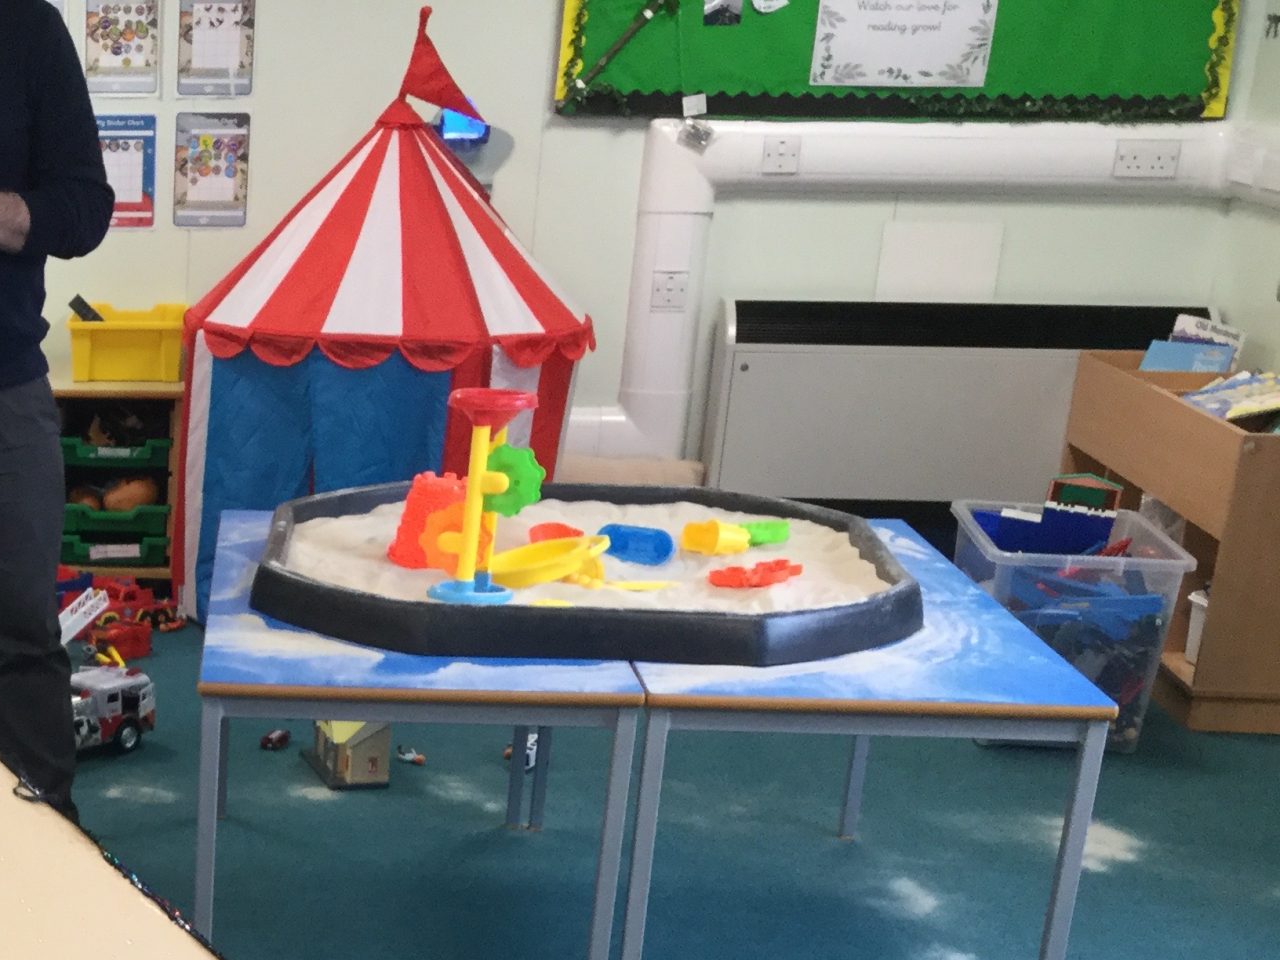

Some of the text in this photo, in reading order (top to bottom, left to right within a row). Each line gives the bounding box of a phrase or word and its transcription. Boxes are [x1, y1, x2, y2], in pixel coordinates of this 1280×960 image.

[857, 0, 892, 11] Watch
[940, 0, 960, 16] for
[867, 20, 907, 35] reading
